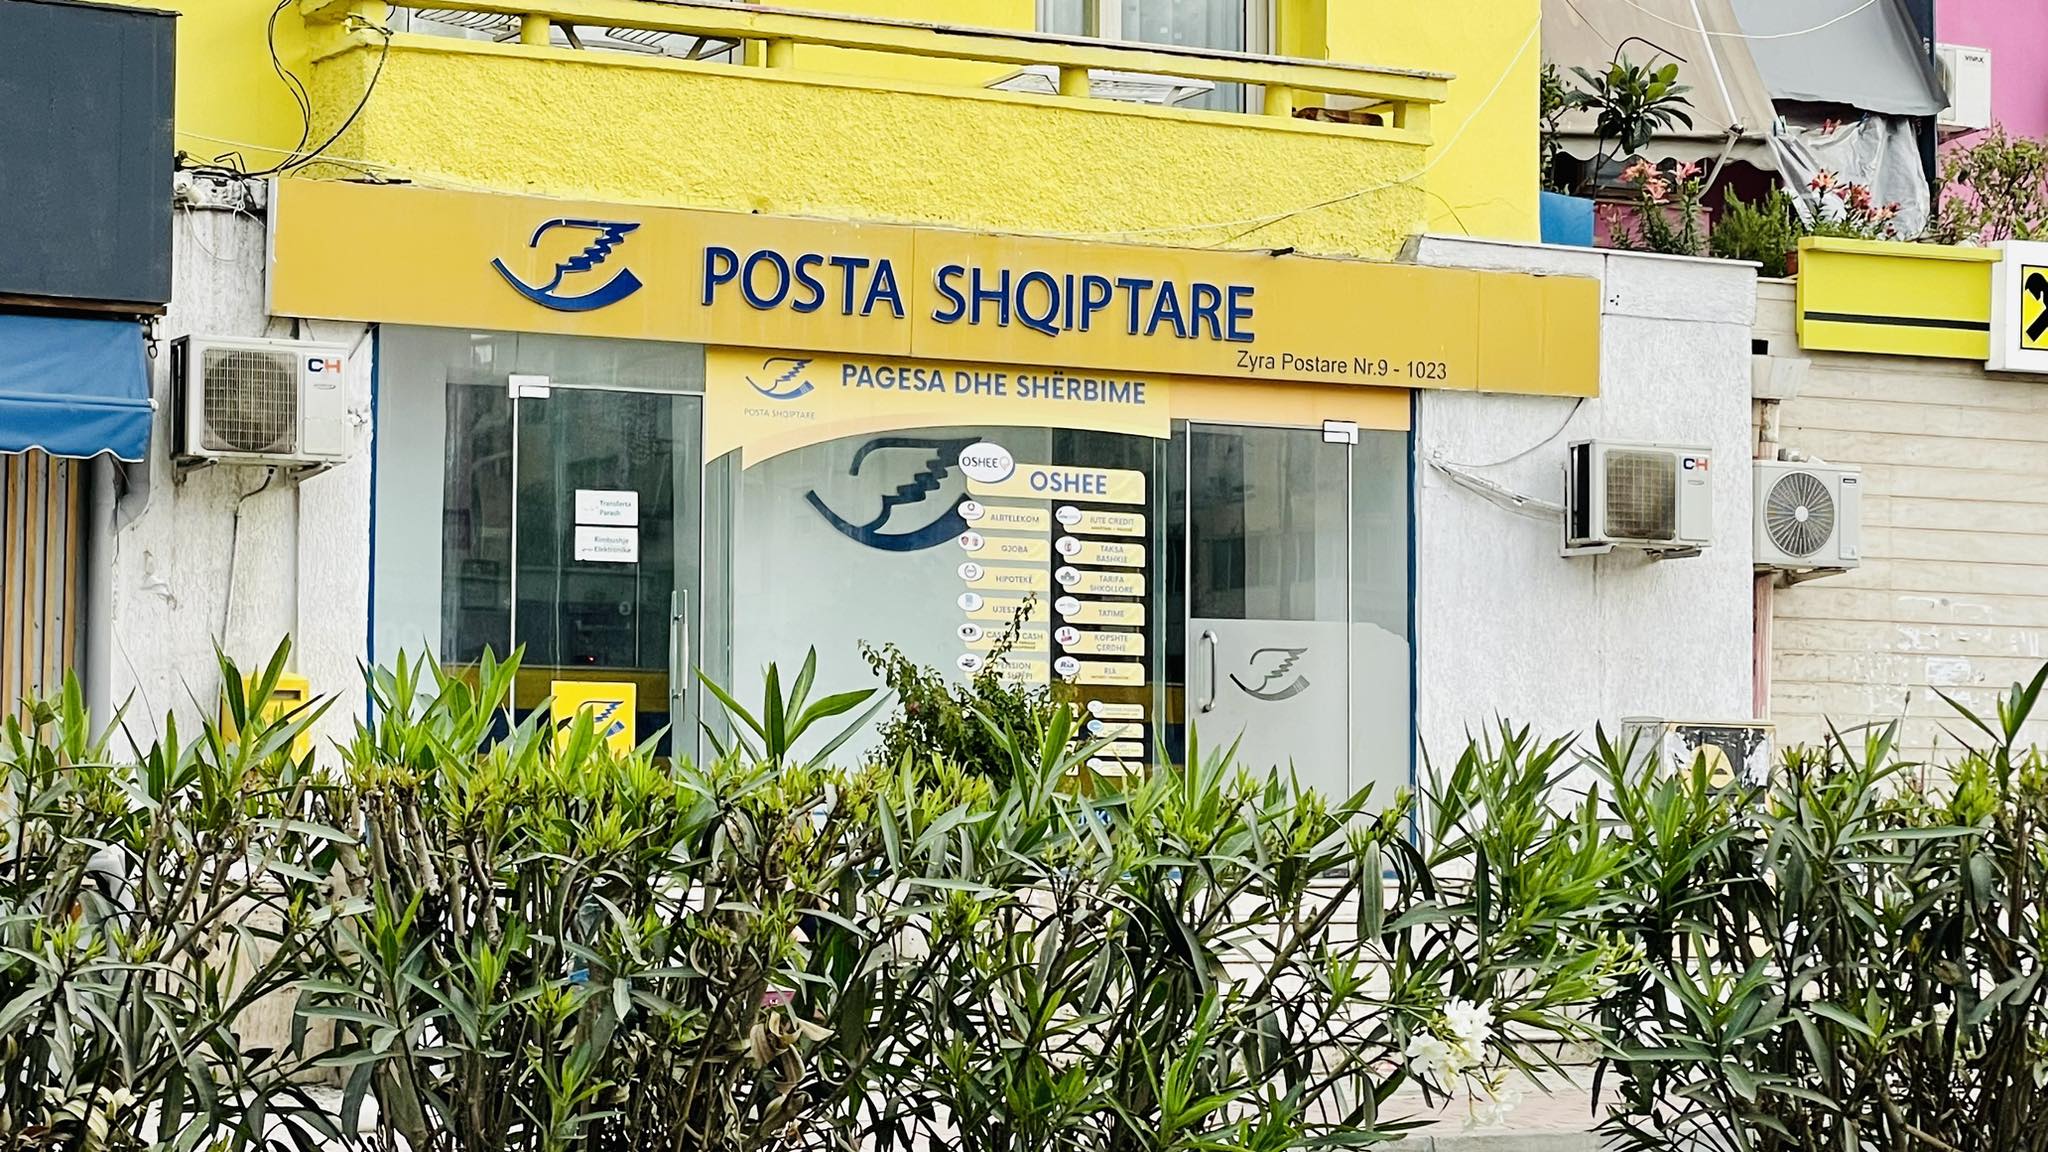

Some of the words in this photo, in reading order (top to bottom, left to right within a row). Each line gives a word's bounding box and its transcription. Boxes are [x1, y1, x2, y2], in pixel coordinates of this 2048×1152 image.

[702, 246, 905, 319] POSTA
[931, 264, 1255, 343] SHQIPTARE
[308, 358, 341, 373] CH
[1236, 350, 1275, 372] Zyra
[1281, 352, 1348, 374] Postare
[1353, 357, 1388, 376] Nr.9
[1407, 361, 1447, 380] 1023
[842, 363, 946, 394] PAGESA
[954, 371, 1008, 397] DHE
[1016, 370, 1146, 405] SHËRBIME
[744, 407, 770, 417] POSTA
[962, 455, 998, 469] OSHEE
[1683, 457, 1708, 471] CH
[1030, 470, 1107, 495] OSHEE
[990, 514, 1040, 523] ALBTELEKOM
